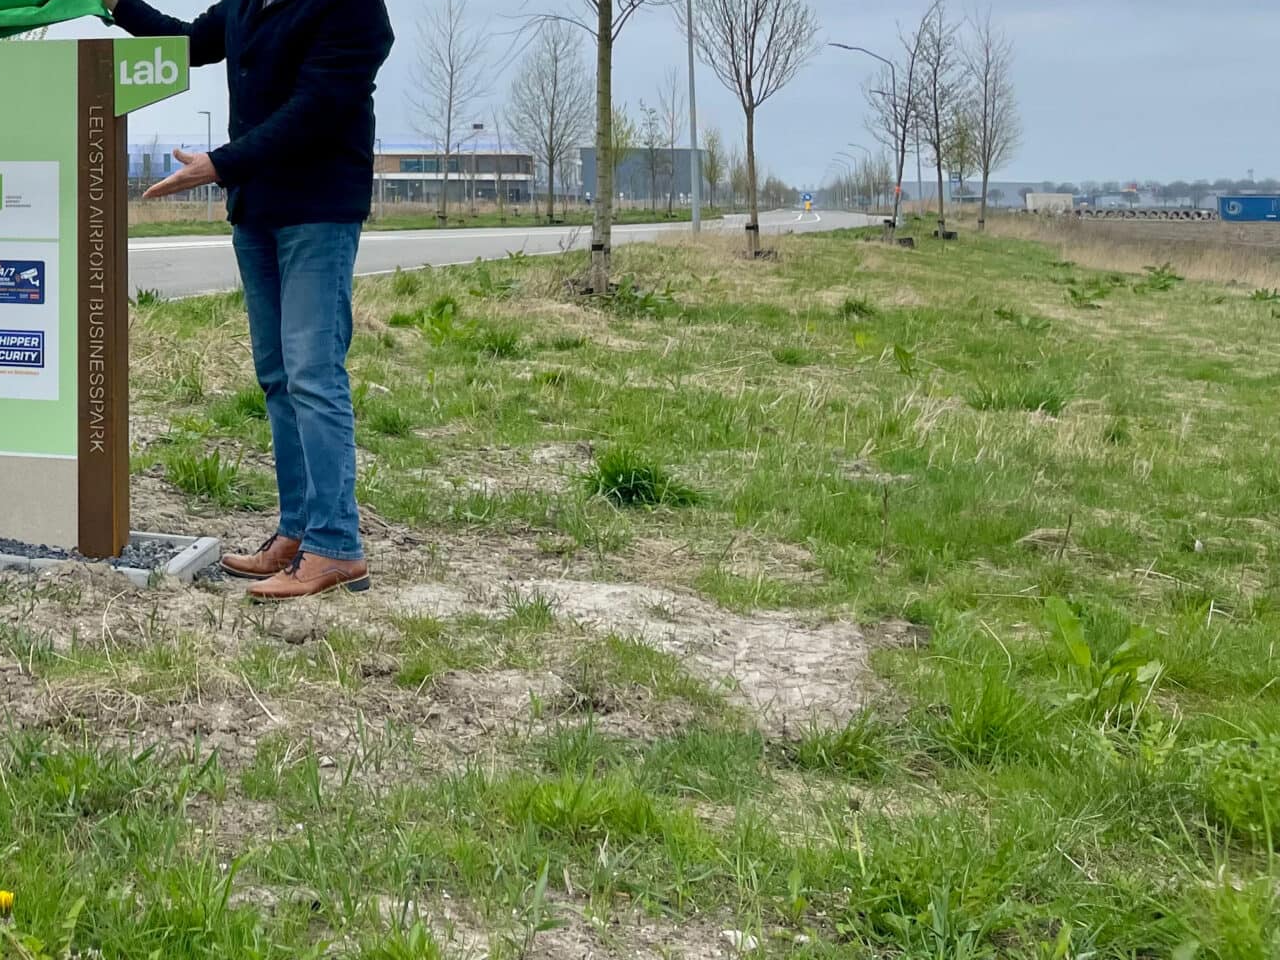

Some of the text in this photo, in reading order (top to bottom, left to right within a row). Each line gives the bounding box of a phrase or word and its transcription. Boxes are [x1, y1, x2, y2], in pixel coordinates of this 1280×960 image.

[119, 46, 179, 86] Lab
[88, 105, 106, 453] LELYSTAD AIRPORT BUSINESSPARK
